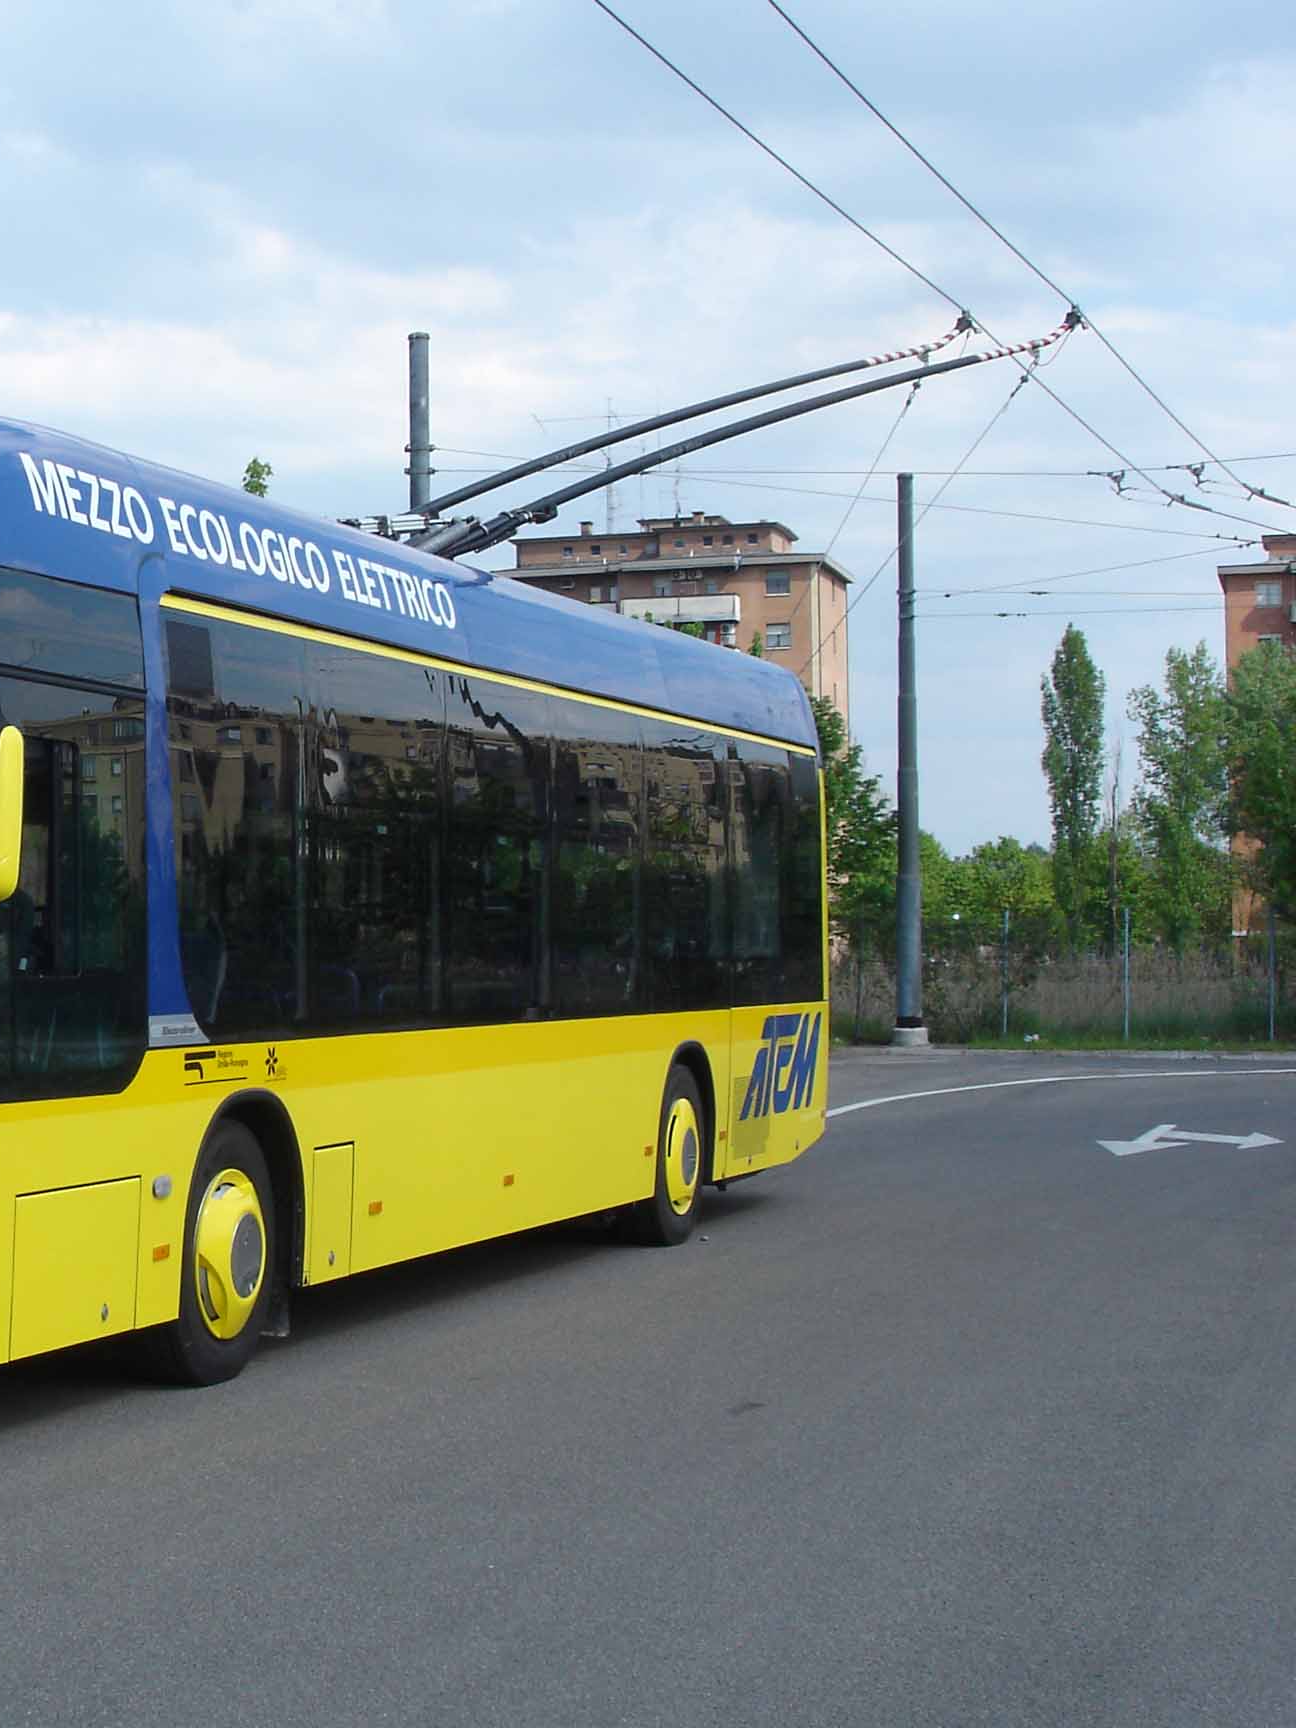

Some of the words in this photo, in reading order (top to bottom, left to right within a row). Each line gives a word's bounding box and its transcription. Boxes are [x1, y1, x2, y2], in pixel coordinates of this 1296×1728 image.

[18, 451, 154, 545] MEZZO
[159, 496, 330, 593] ECOLOGICO
[331, 550, 456, 629] ELETTRICO
